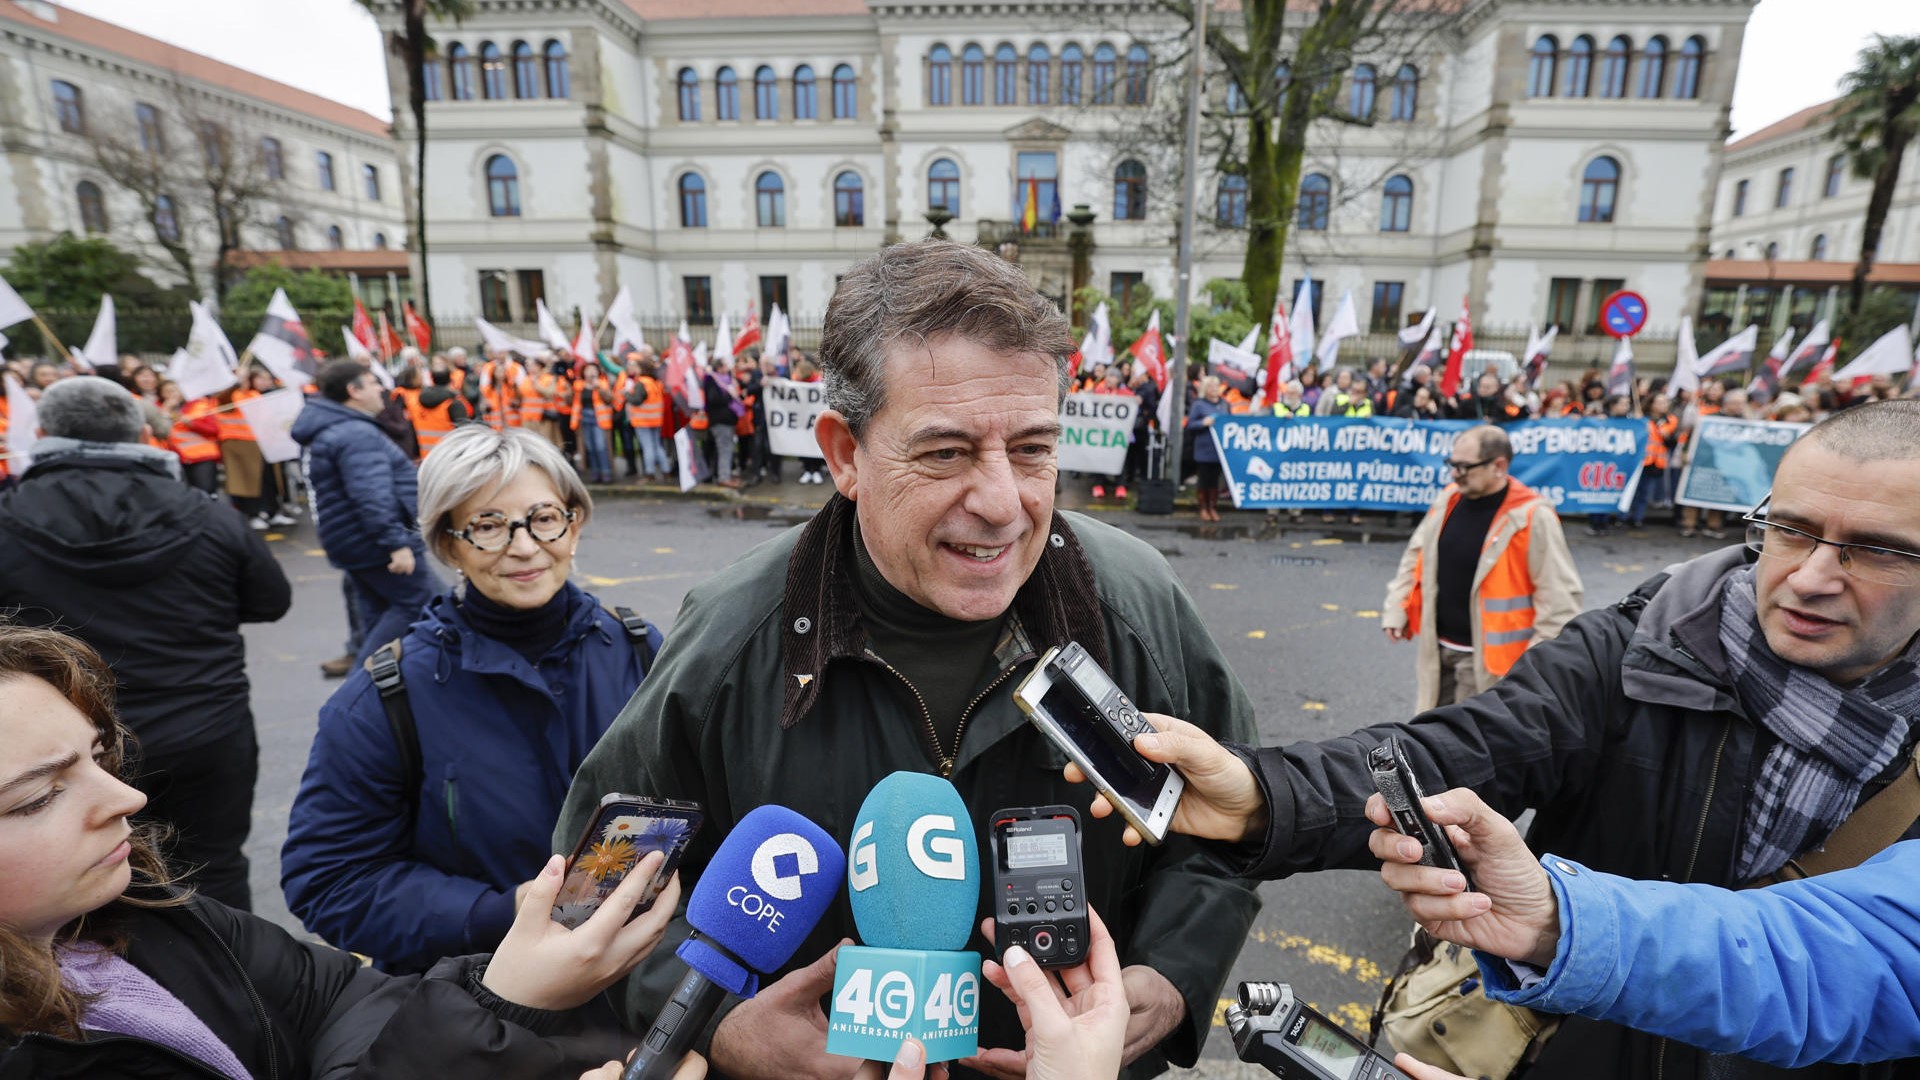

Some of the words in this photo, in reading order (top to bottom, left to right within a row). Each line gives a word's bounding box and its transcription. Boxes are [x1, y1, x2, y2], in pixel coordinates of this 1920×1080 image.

[771, 385, 800, 402] NA
[770, 411, 797, 429] DE
[1066, 401, 1129, 419] BLICO
[1060, 427, 1126, 448] NCIA
[1223, 422, 1272, 452] PARA
[1276, 423, 1330, 452] UNHA
[1334, 421, 1428, 454] ATENCIÓN
[1279, 461, 1353, 480] SISTEMA
[1356, 459, 1435, 484] PÚBLICO
[1250, 482, 1331, 501] SERVIZOS
[1334, 483, 1359, 501] DE
[1360, 482, 1438, 505] ATENCIÓ
[906, 814, 965, 880] G
[727, 886, 785, 933] COPE
[832, 1022, 912, 1040] ANIVERSARIO
[922, 1026, 978, 1040] ANIVERSARIO
[1290, 1015, 1306, 1037] TASCAM
